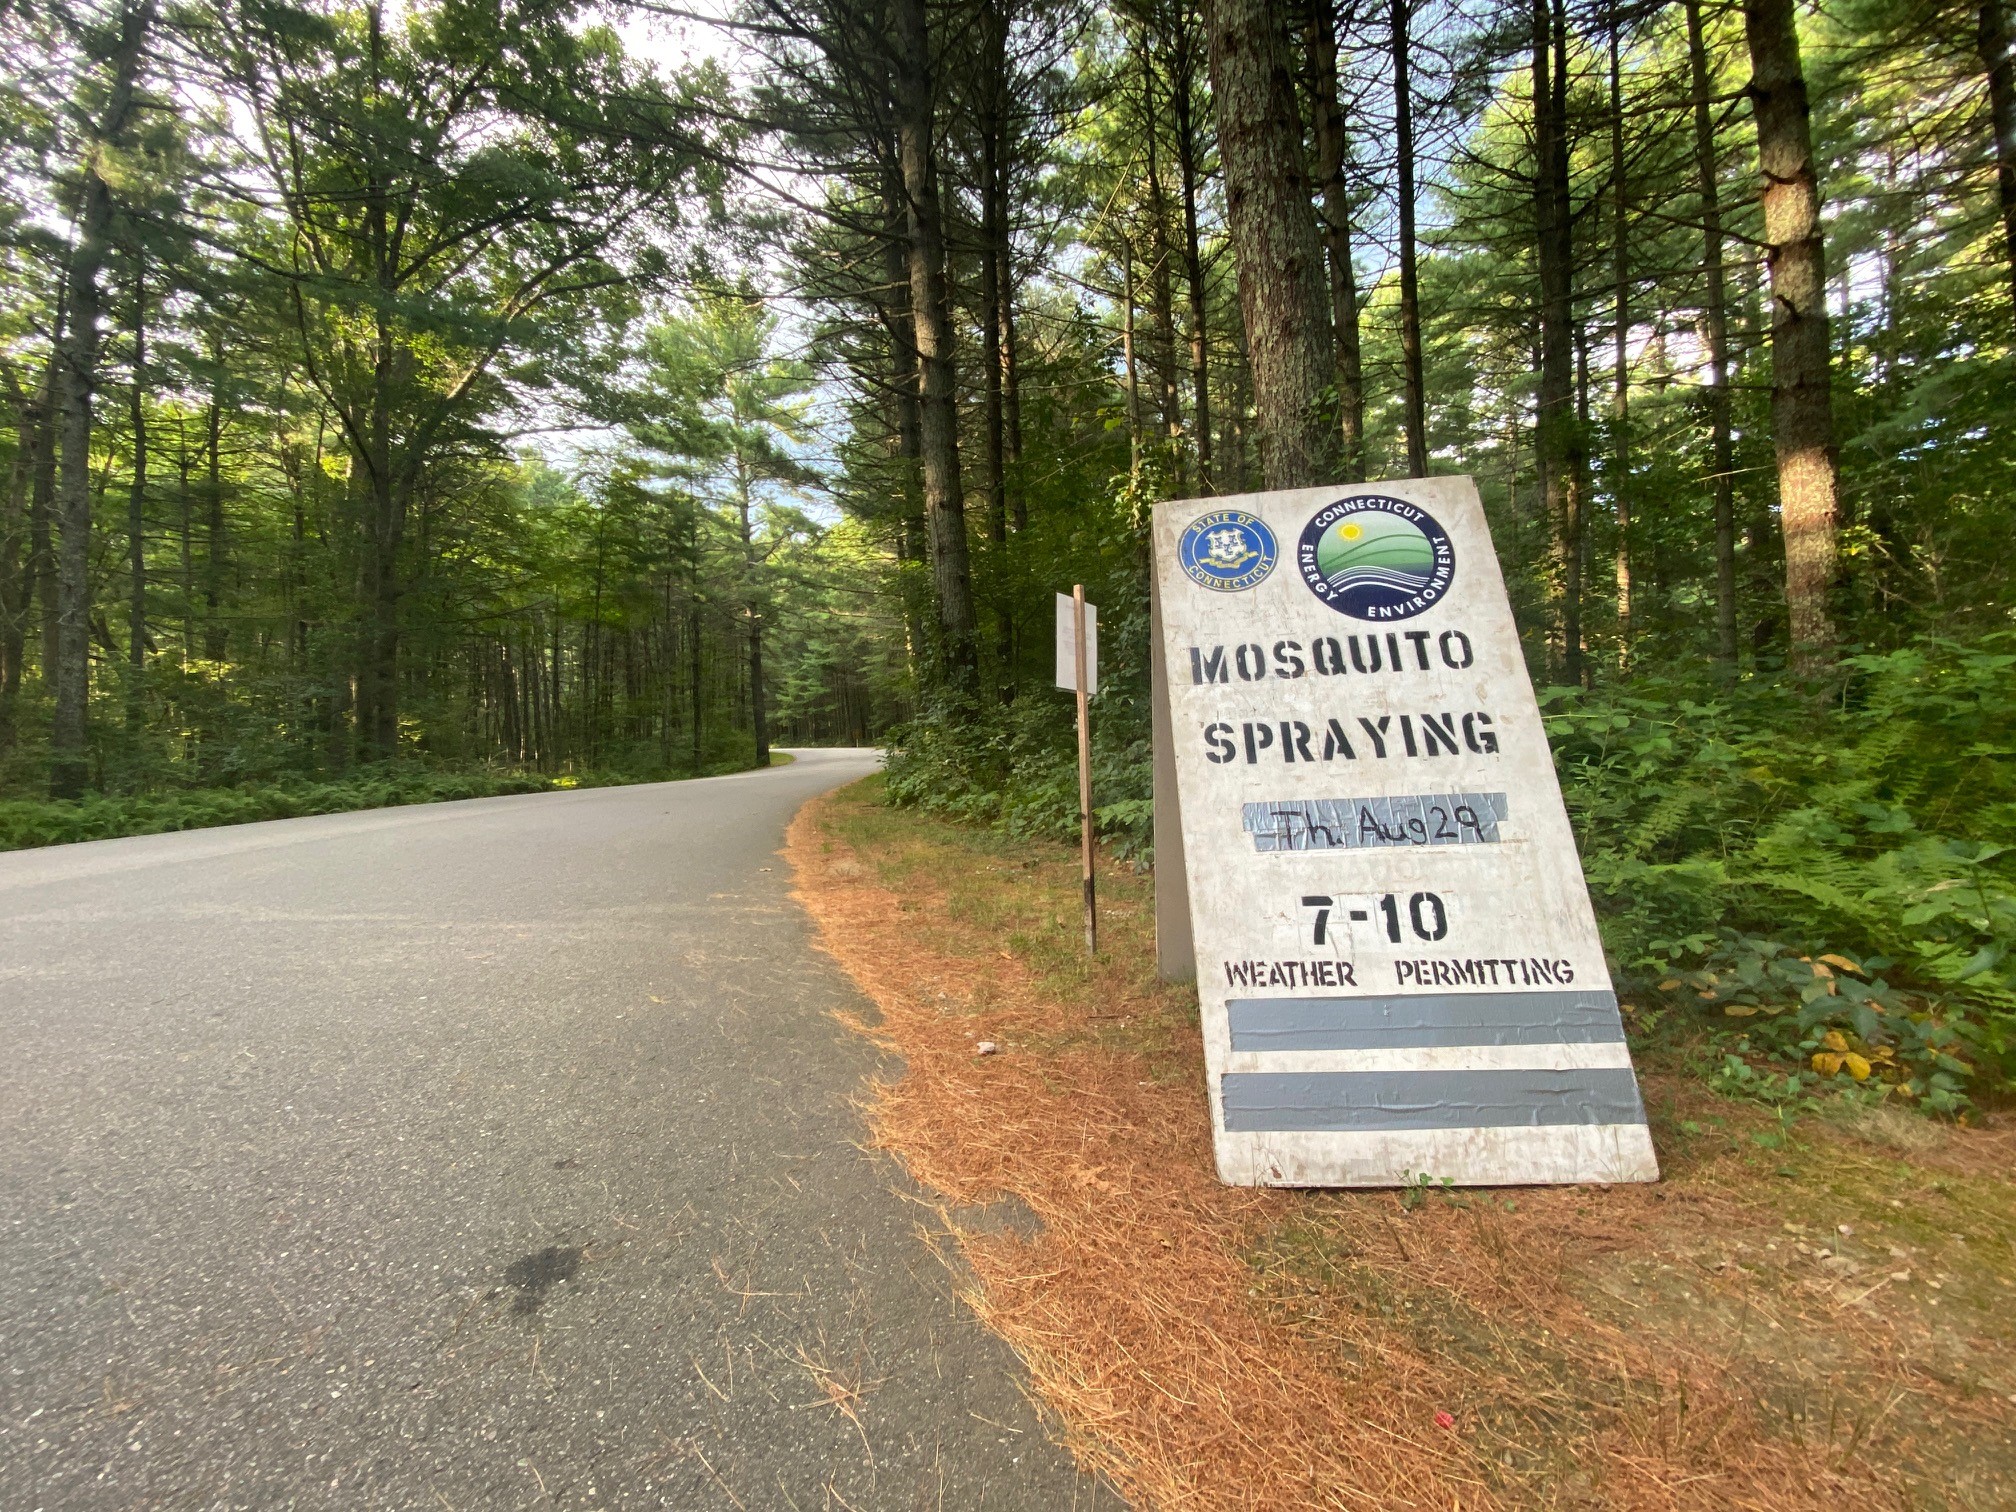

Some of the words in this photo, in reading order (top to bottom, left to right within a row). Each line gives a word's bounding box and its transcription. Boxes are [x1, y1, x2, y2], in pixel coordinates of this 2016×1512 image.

[1192, 513, 1229, 533] STATE
[1237, 514, 1254, 526] OF
[1315, 499, 1424, 527] CONNECTICUT
[1189, 555, 1272, 589] CONNECTICUT
[1301, 544, 1338, 601] ENERGY
[1367, 536, 1450, 617] ENVIRONMENT
[1190, 630, 1474, 685] MOSQUITO
[1203, 712, 1500, 764] SPRAYING
[1302, 892, 1449, 945] 7-10
[1224, 960, 1358, 988] WEATHER
[1395, 957, 1574, 985] PERMITTING
